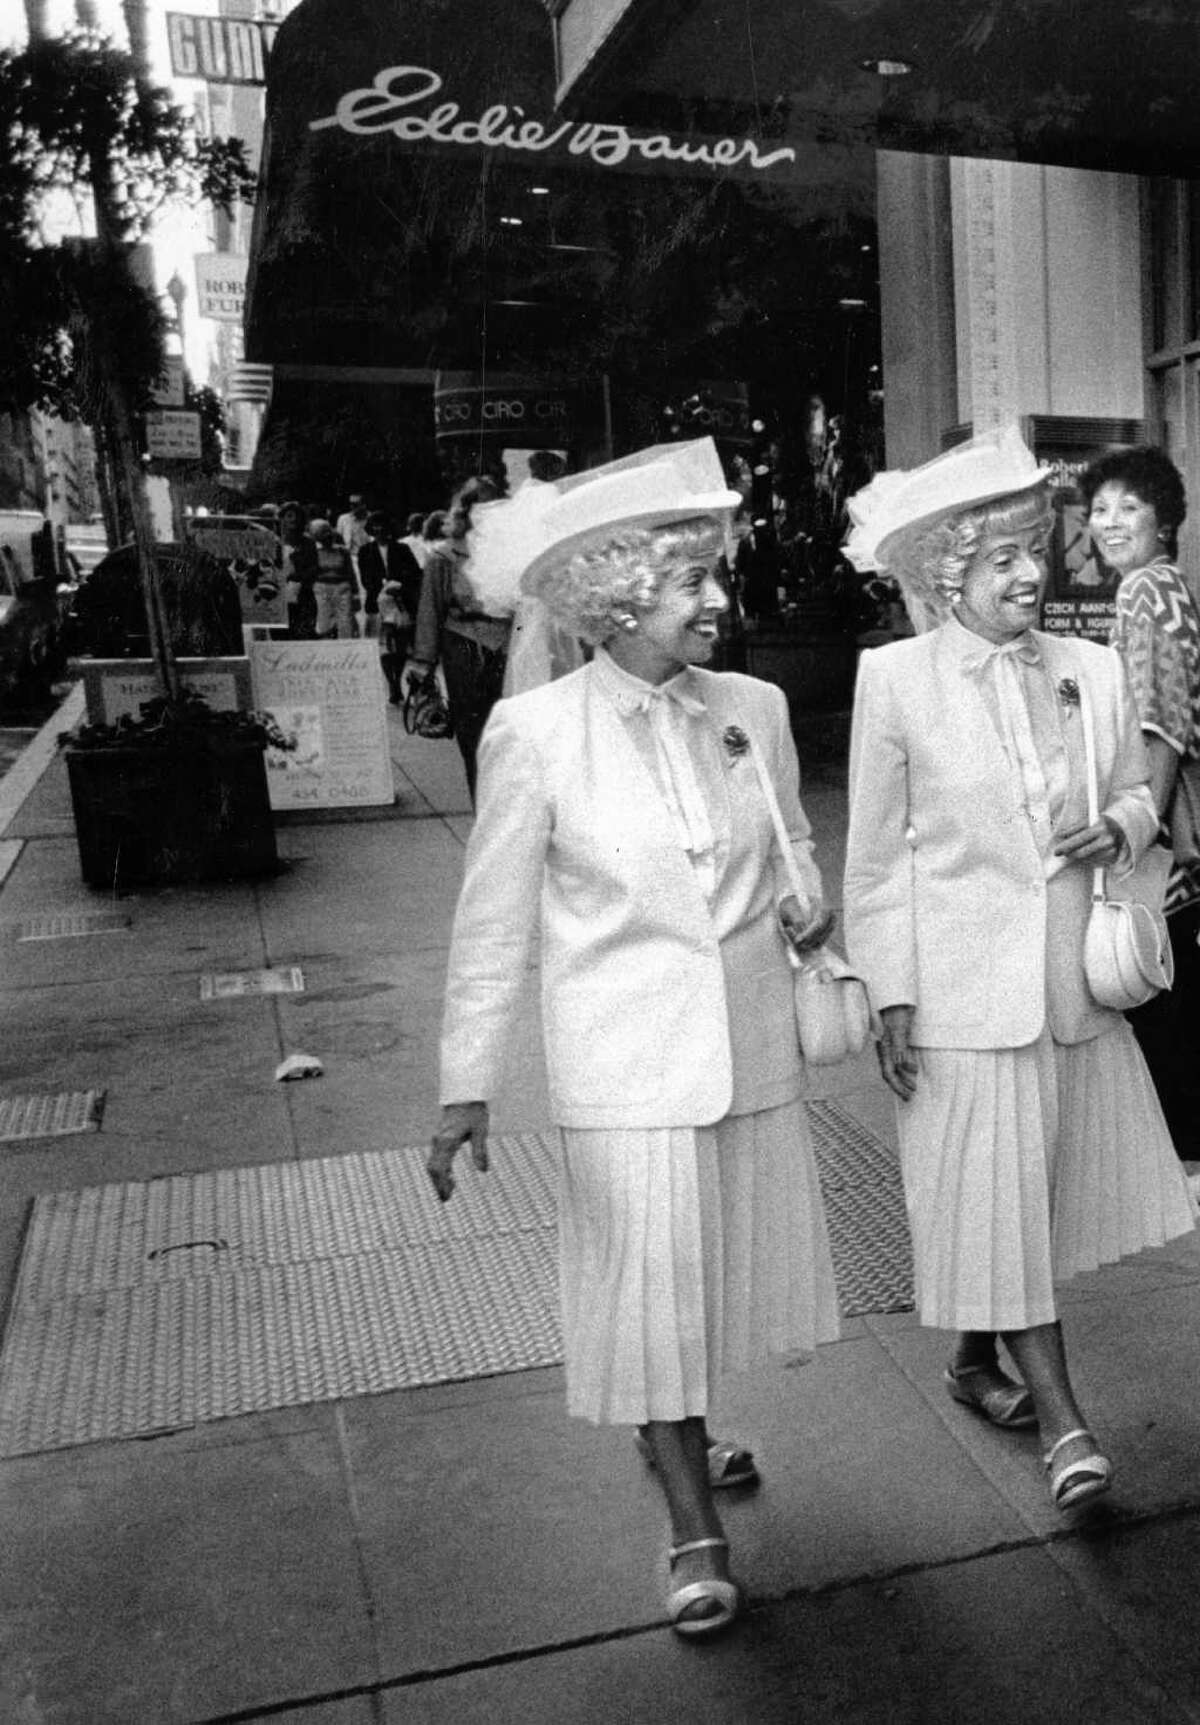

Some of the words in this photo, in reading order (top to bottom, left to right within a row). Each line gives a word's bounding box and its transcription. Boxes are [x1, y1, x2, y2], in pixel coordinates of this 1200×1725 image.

[169, 15, 279, 81] GUM
[309, 65, 573, 151] Eddie
[567, 120, 796, 168] Bauer
[1044, 603, 1075, 615] CZECH
[1044, 618, 1070, 630] FORM
[1074, 618, 1083, 629] &
